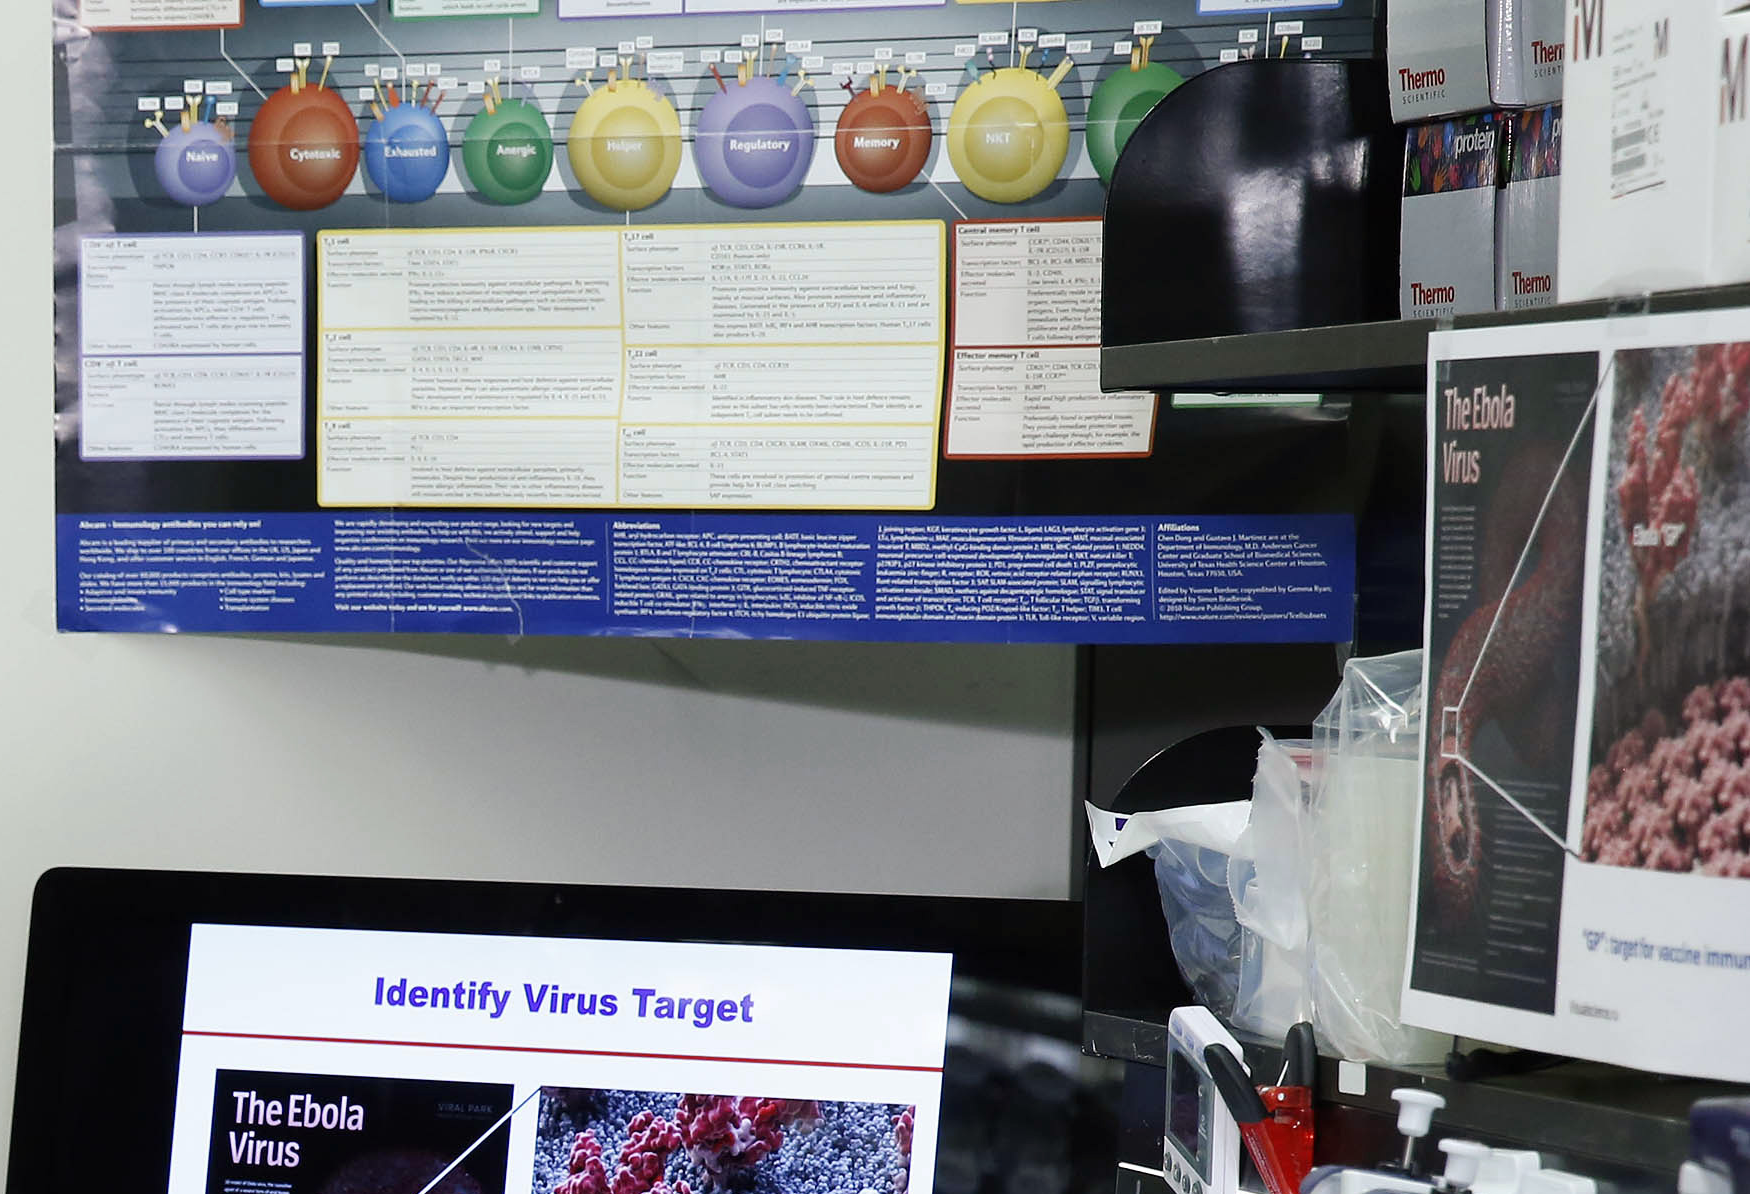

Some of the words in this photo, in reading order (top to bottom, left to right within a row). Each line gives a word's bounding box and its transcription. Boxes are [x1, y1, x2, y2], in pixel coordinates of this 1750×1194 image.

[1399, 68, 1444, 91] Thermo
[1402, 90, 1445, 105] SCIENTIFIC
[854, 136, 899, 150] Memory
[986, 131, 1011, 144] NKT
[1455, 128, 1495, 159] protein
[384, 145, 436, 157] Exhausted
[496, 144, 536, 159] Anergic
[730, 138, 790, 153] Regulatory
[186, 151, 218, 162] Naive
[290, 148, 341, 161] Cytotoxic
[958, 226, 987, 235] Central
[988, 227, 1018, 236] memory
[1021, 226, 1025, 234] T
[1026, 226, 1040, 234] cell
[1512, 272, 1551, 294] Thermo
[1411, 283, 1454, 306] Thermo
[1515, 295, 1552, 308] SCIENTIFIC
[1413, 309, 1454, 317] SCIENTIFIC
[956, 351, 987, 360] Effector
[988, 352, 1018, 361] memory
[1020, 351, 1025, 359] T
[1026, 351, 1040, 359] cell
[1444, 388, 1470, 430] The
[1473, 384, 1515, 430] Ebola
[1443, 441, 1481, 484] Virus
[79, 521, 107, 529] Abcam
[112, 521, 161, 530] Immunology
[161, 520, 202, 529] antibodies
[202, 522, 217, 530] you
[233, 520, 248, 530] rely
[249, 520, 262, 528] on!
[613, 521, 661, 530] Abbreviations
[1158, 524, 1200, 532] Affiliations
[1609, 936, 1638, 961] target
[1639, 936, 1655, 960] for
[1658, 943, 1701, 966] vaccine
[374, 976, 511, 1016] Identify
[523, 983, 618, 1016] Virus
[631, 988, 754, 1026] Target
[232, 1092, 285, 1126] The
[287, 1094, 364, 1130] Ebola
[229, 1131, 300, 1166] Virus
